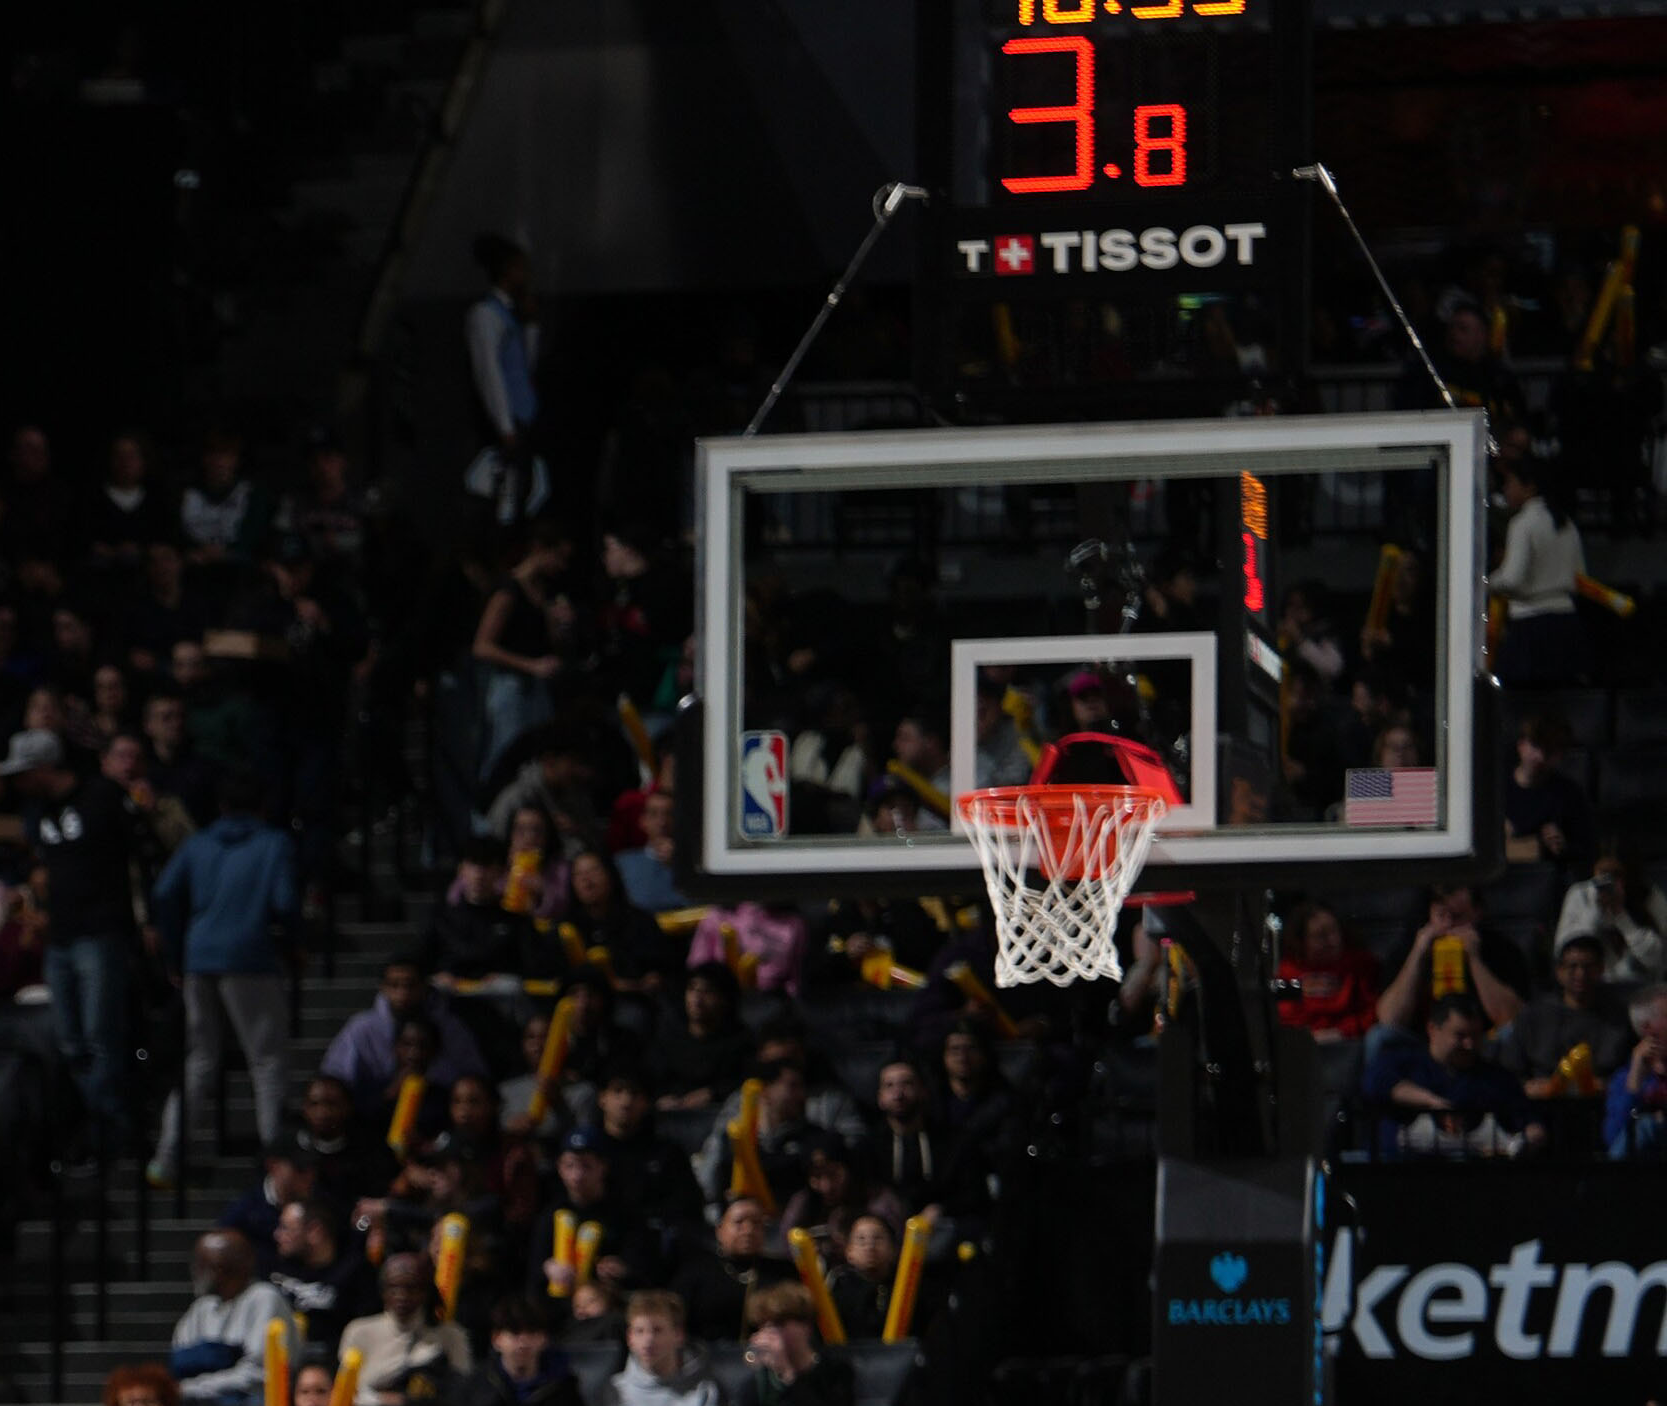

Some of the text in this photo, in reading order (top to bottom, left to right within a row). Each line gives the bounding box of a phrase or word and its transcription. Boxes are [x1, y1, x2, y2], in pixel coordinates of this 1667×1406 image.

[1001, 36, 1187, 193] 3.8
[1040, 222, 1267, 274] TISSOT
[1169, 1298, 1290, 1325] BARCLAYS
